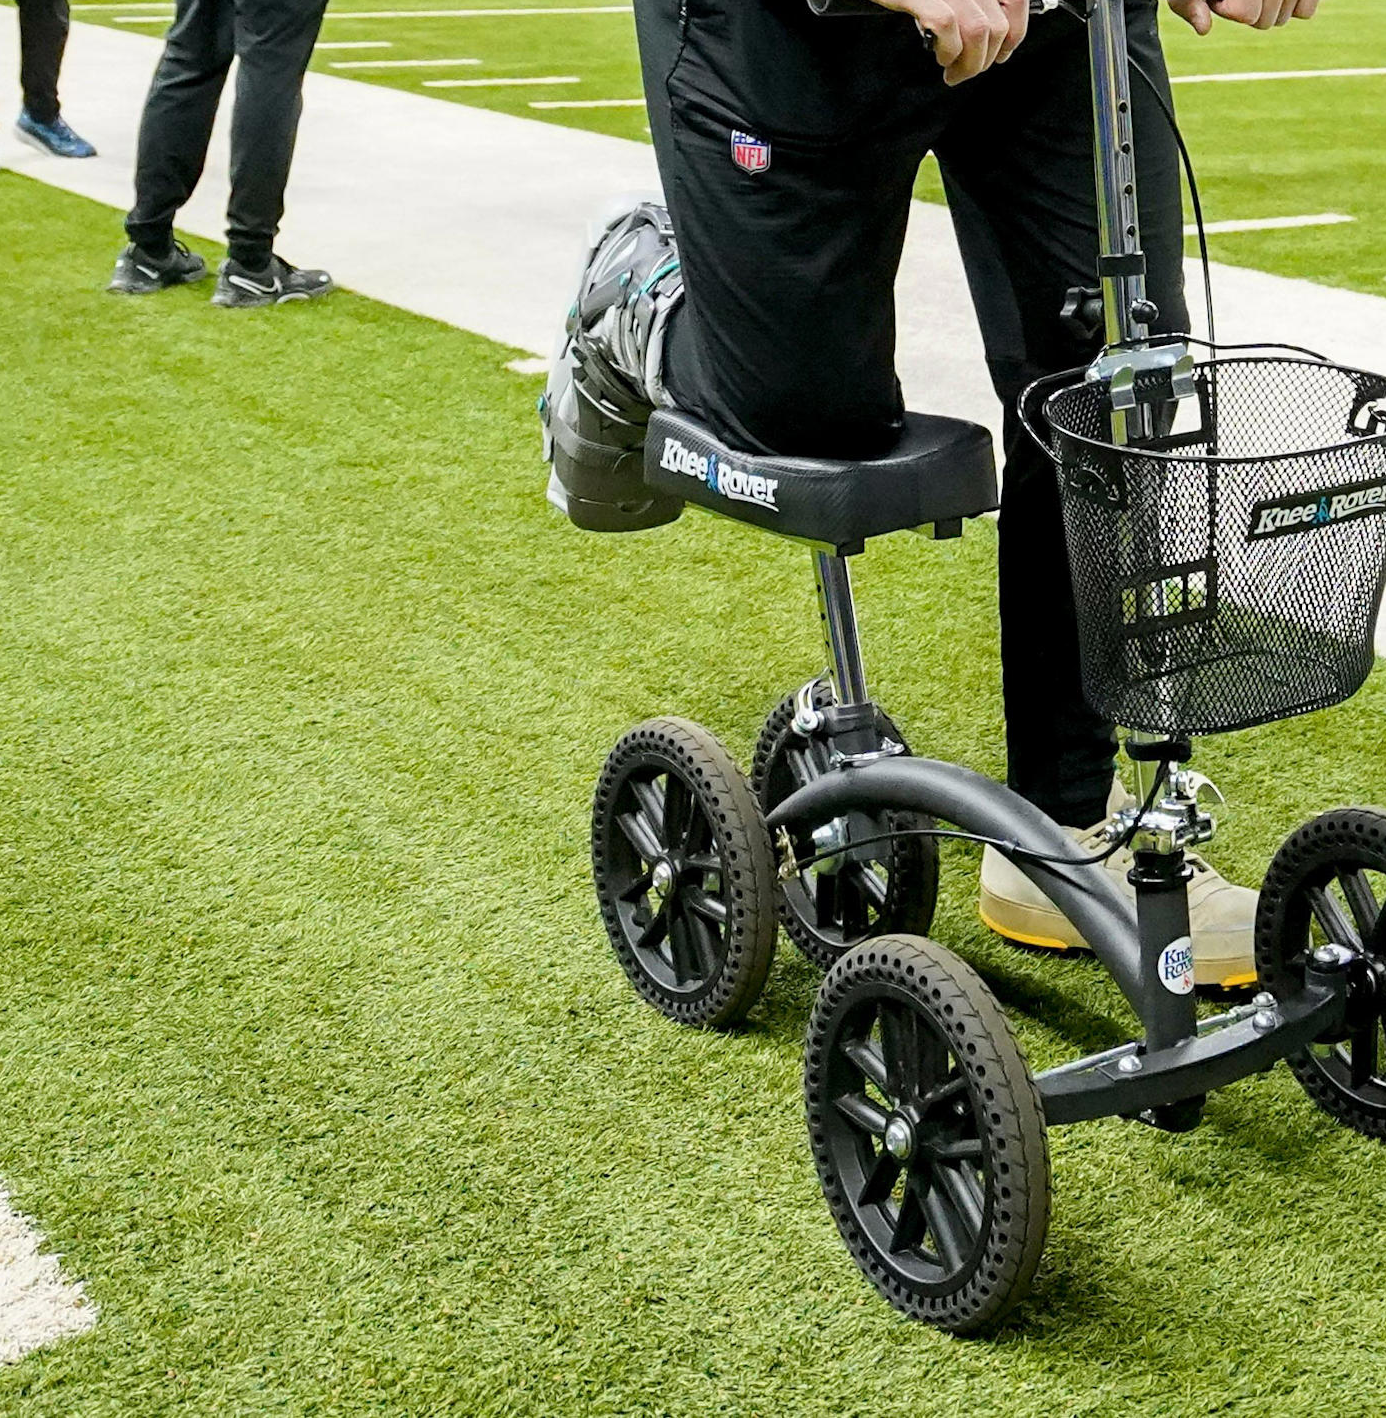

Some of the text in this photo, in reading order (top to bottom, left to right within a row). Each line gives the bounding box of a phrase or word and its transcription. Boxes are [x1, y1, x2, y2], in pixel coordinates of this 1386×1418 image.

[735, 145, 766, 168] NFL
[660, 437, 779, 512] Knee Rover
[1254, 503, 1318, 534] Knee
[1165, 946, 1192, 965] Kne
[1165, 960, 1193, 980] Rov
